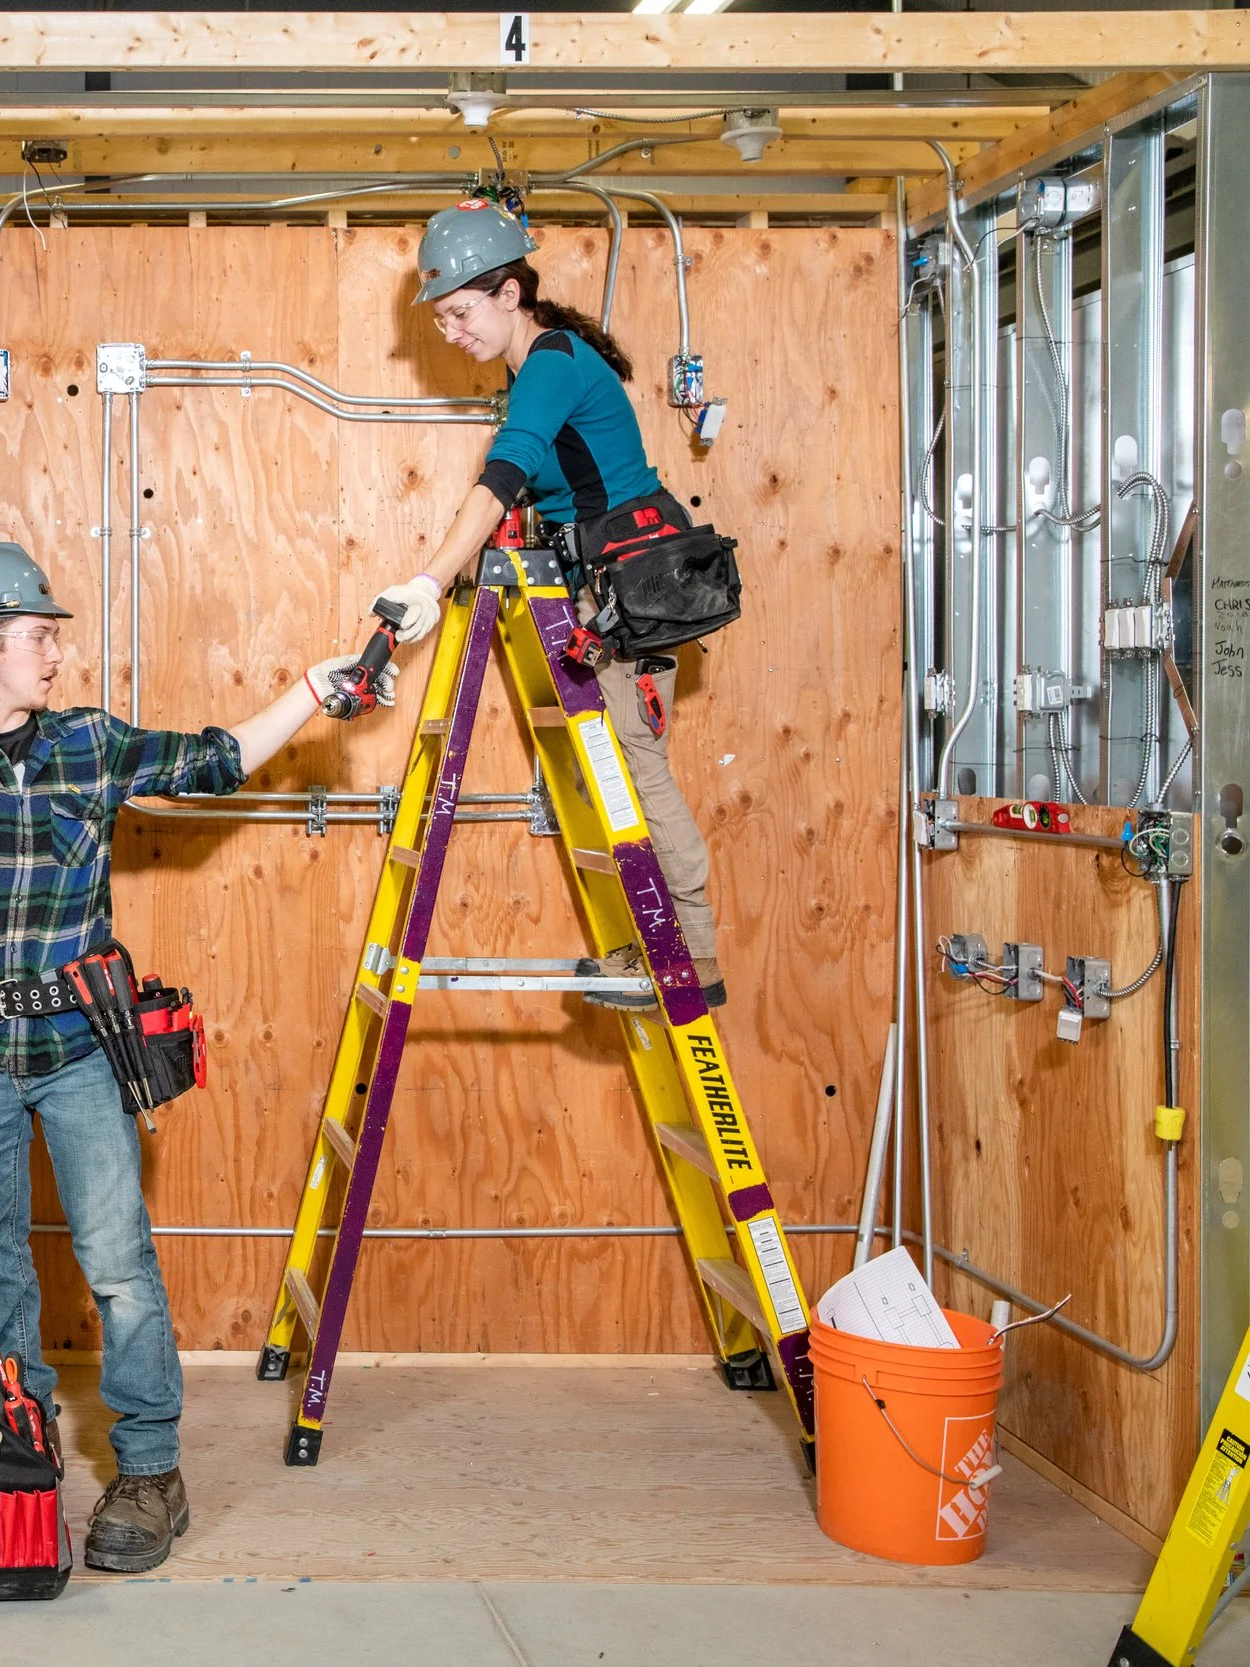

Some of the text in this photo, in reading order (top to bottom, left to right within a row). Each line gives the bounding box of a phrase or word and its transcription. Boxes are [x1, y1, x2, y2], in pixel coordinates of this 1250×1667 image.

[505, 15, 526, 62] 4
[1215, 640, 1244, 659] John
[1211, 659, 1243, 678] Jess
[686, 1034, 753, 1170] FEATHERLITE
